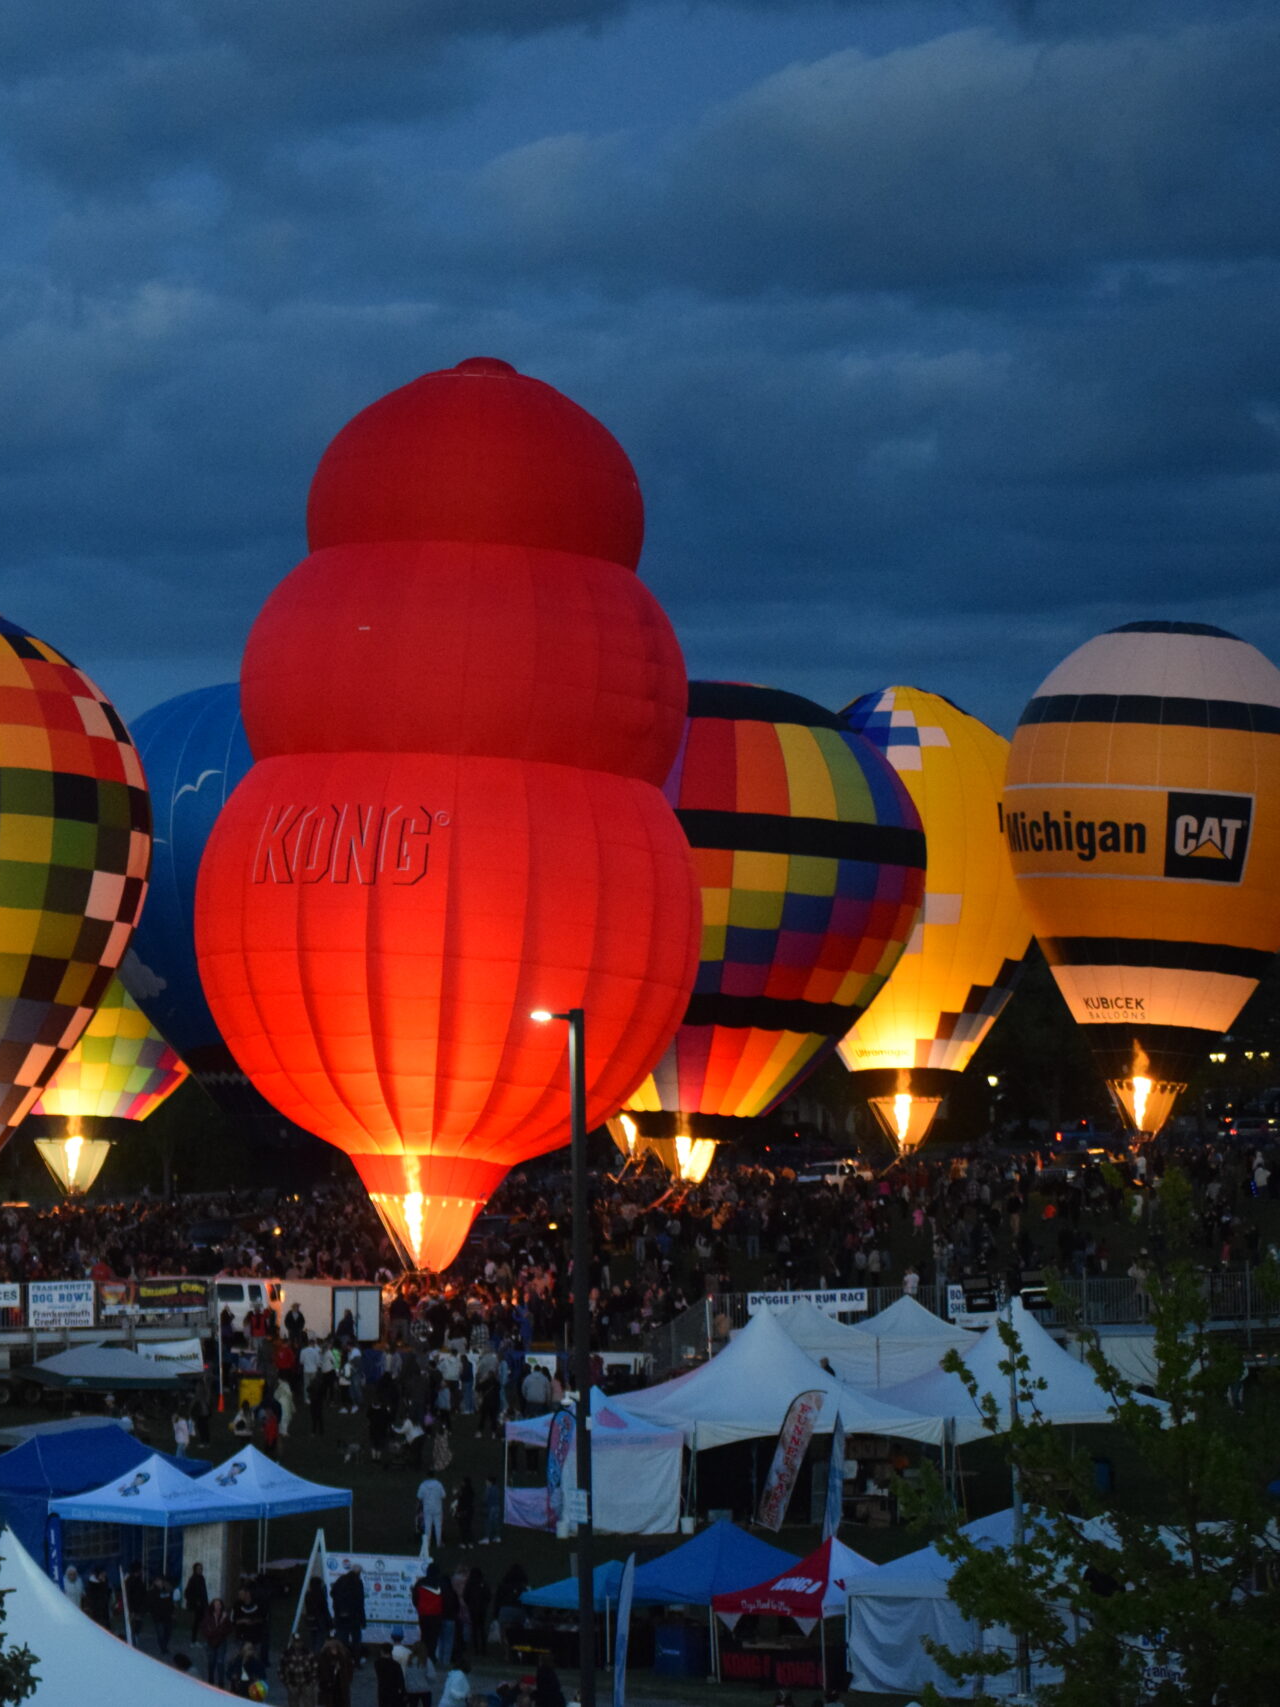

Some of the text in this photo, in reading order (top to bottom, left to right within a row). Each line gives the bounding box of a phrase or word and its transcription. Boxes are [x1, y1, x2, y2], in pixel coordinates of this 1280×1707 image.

[1007, 809, 1242, 862] Michigan CAT
[32, 1292, 92, 1303] DOG BOWL
[816, 1294, 836, 1303] RUN
[841, 1292, 865, 1302] RACE
[770, 1576, 813, 1592] KONG
